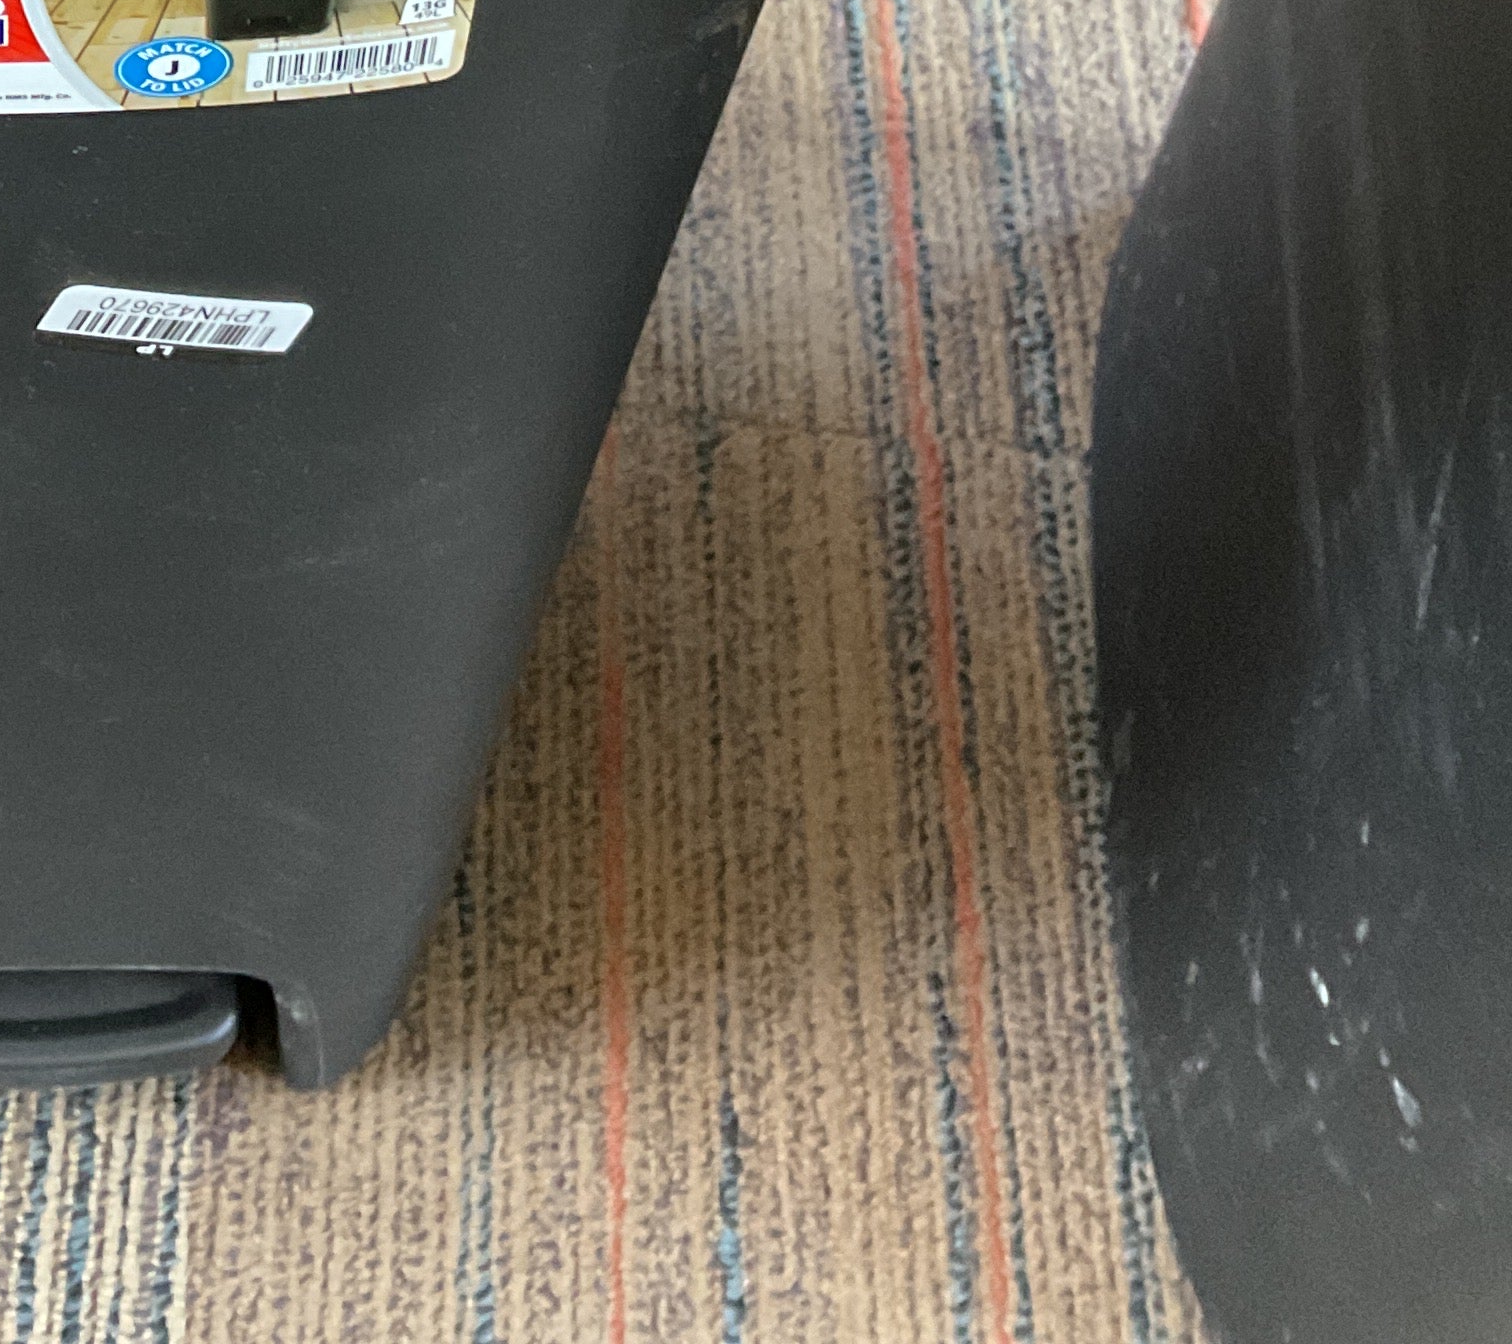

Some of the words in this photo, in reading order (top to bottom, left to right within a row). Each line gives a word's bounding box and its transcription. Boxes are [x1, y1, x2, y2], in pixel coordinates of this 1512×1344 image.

[137, 42, 212, 60] MATCH
[165, 60, 179, 76] J
[140, 79, 166, 91] TO
[172, 78, 205, 92] LID
[99, 296, 271, 324] LPHN429670
